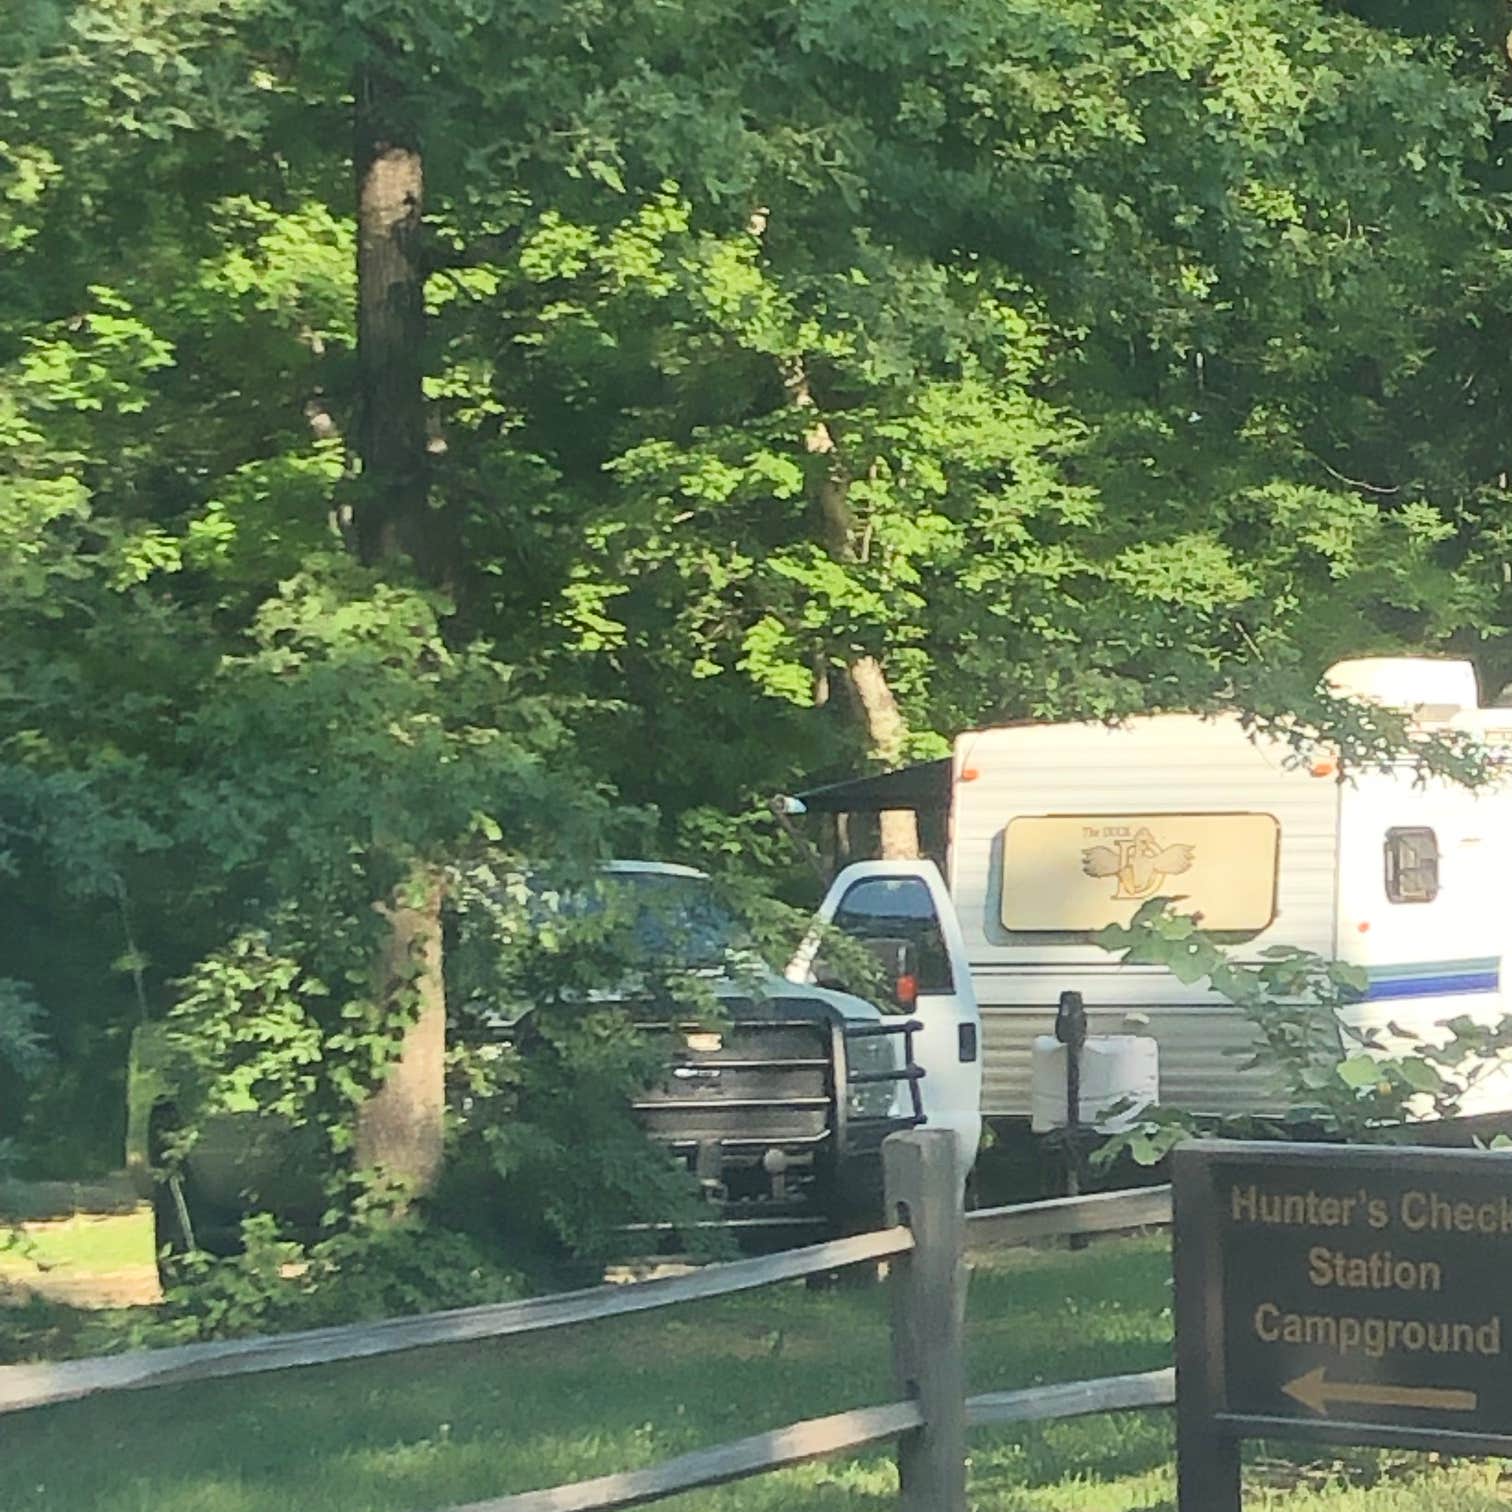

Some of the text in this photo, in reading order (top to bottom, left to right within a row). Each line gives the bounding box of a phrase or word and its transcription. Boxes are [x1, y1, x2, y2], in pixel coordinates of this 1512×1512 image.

[1231, 1184, 1388, 1229] Hunter's
[1308, 1246, 1441, 1291] Station
[1254, 1303, 1500, 1358] Campground
